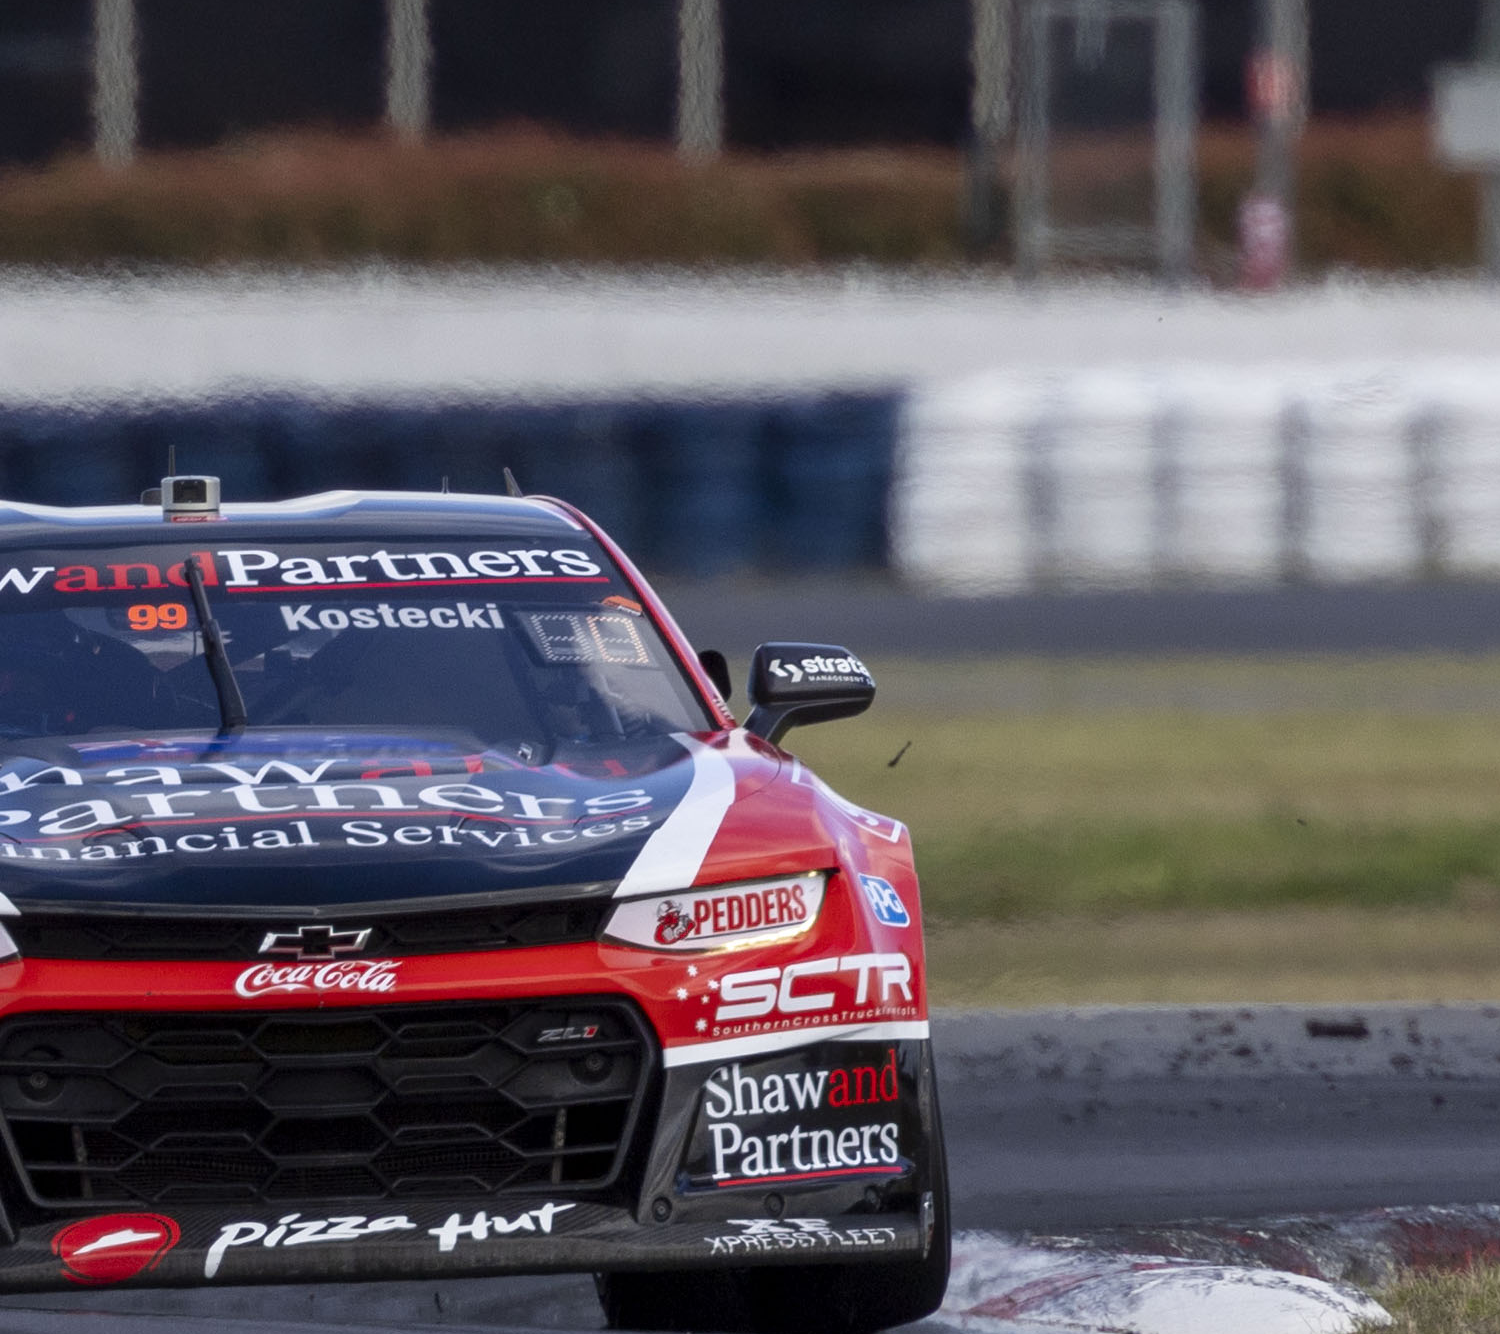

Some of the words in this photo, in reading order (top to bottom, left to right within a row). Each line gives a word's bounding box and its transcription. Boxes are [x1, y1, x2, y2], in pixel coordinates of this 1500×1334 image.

[127, 603, 187, 631] 99
[279, 602, 506, 632] Kostecki
[341, 814, 652, 848] Services
[693, 884, 808, 936] PEDDERS
[234, 960, 403, 998] Coca-Cola
[715, 952, 913, 1022] SCTR
[537, 1025, 599, 1042] ZL1
[708, 1122, 899, 1180] Partners
[427, 1202, 577, 1252] Hut
[704, 1231, 816, 1255] XPRESS
[816, 1228, 896, 1247] FLEET
